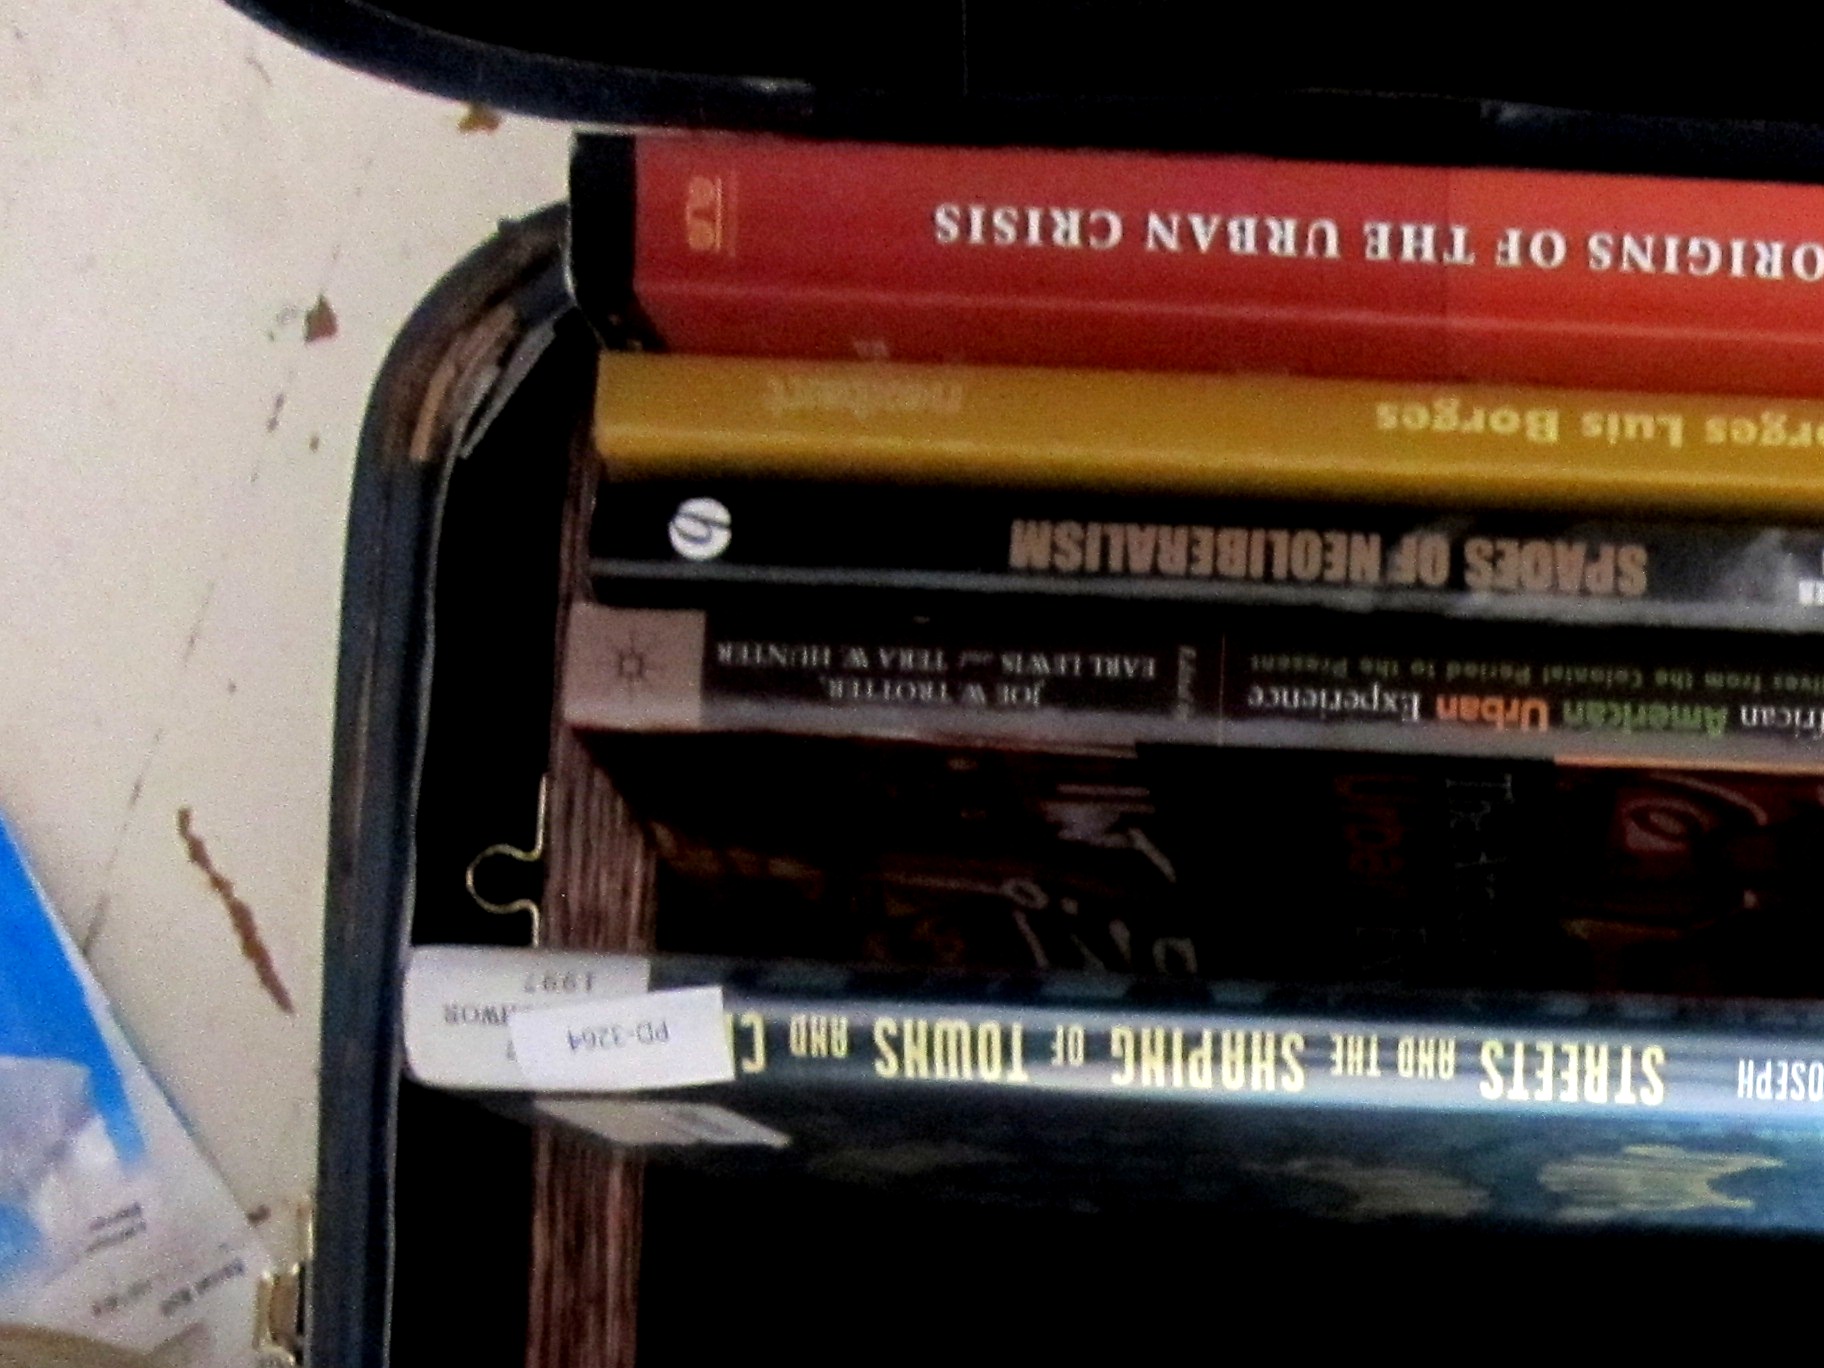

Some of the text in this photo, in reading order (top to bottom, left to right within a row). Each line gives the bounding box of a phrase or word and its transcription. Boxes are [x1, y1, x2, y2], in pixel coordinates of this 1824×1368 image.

[930, 200, 1124, 250] CRISIS
[1144, 209, 1340, 259] URBAN
[1362, 220, 1475, 266] THE
[1493, 226, 1568, 270] OF
[1375, 396, 1560, 446] Borges
[1579, 408, 1685, 450] Luis
[1007, 516, 1383, 585] NEOLIBERALISM
[1385, 529, 1450, 588] OF
[715, 640, 832, 669] HUNTER
[878, 646, 948, 674] TERA
[999, 650, 1082, 676] LEWIS
[1089, 653, 1155, 678] EARL
[1409, 657, 1436, 681] to
[997, 680, 1046, 709] JOE
[1654, 668, 1693, 691] the
[1704, 673, 1762, 694] from
[1247, 680, 1422, 724] Experience
[1435, 693, 1548, 734] Urban
[1561, 699, 1728, 737] American
[788, 1012, 850, 1060] AND
[871, 1015, 1029, 1084] TOWNS
[1049, 1025, 1086, 1067] OF
[1331, 1032, 1383, 1079] THE
[1109, 1025, 1308, 1092] SHAPING
[1395, 1036, 1456, 1082] AND
[1478, 1039, 1667, 1107] STREETS
